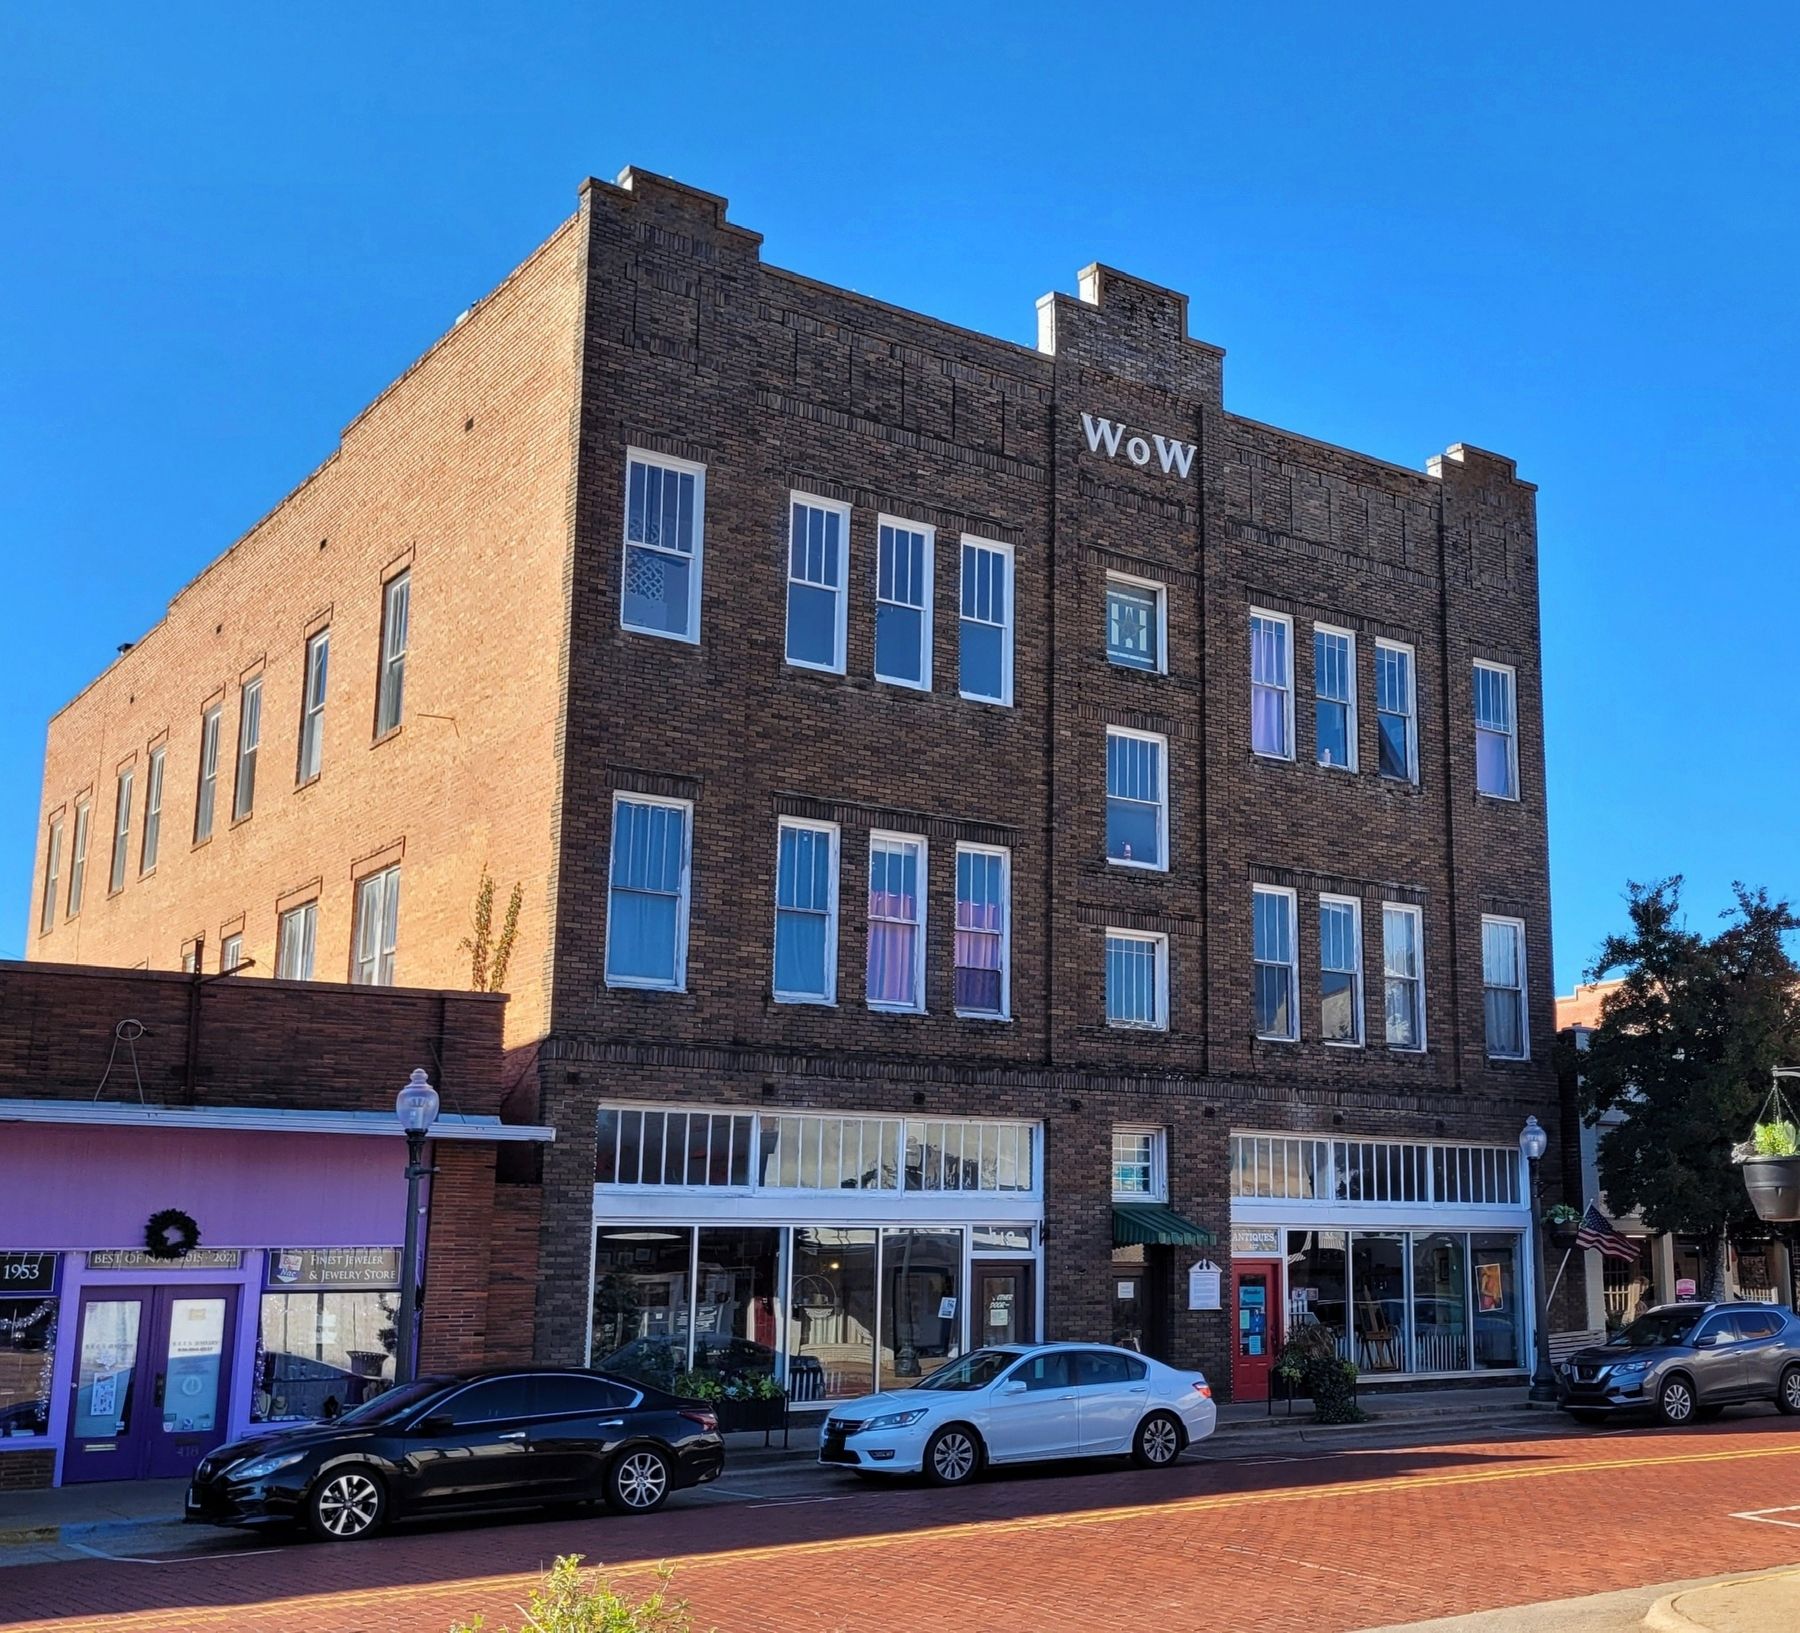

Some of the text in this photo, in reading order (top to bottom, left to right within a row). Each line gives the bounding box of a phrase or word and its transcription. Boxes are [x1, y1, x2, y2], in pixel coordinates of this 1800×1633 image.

[1231, 1232, 1275, 1242] ANTIQUES
[94, 1254, 121, 1264] BEST
[125, 1254, 142, 1264] OF
[213, 1253, 236, 1263] 2021
[310, 1254, 384, 1268] FINEST JEWELER
[3, 1264, 40, 1280] 1953
[309, 1269, 396, 1282] & JEWELRY STORE
